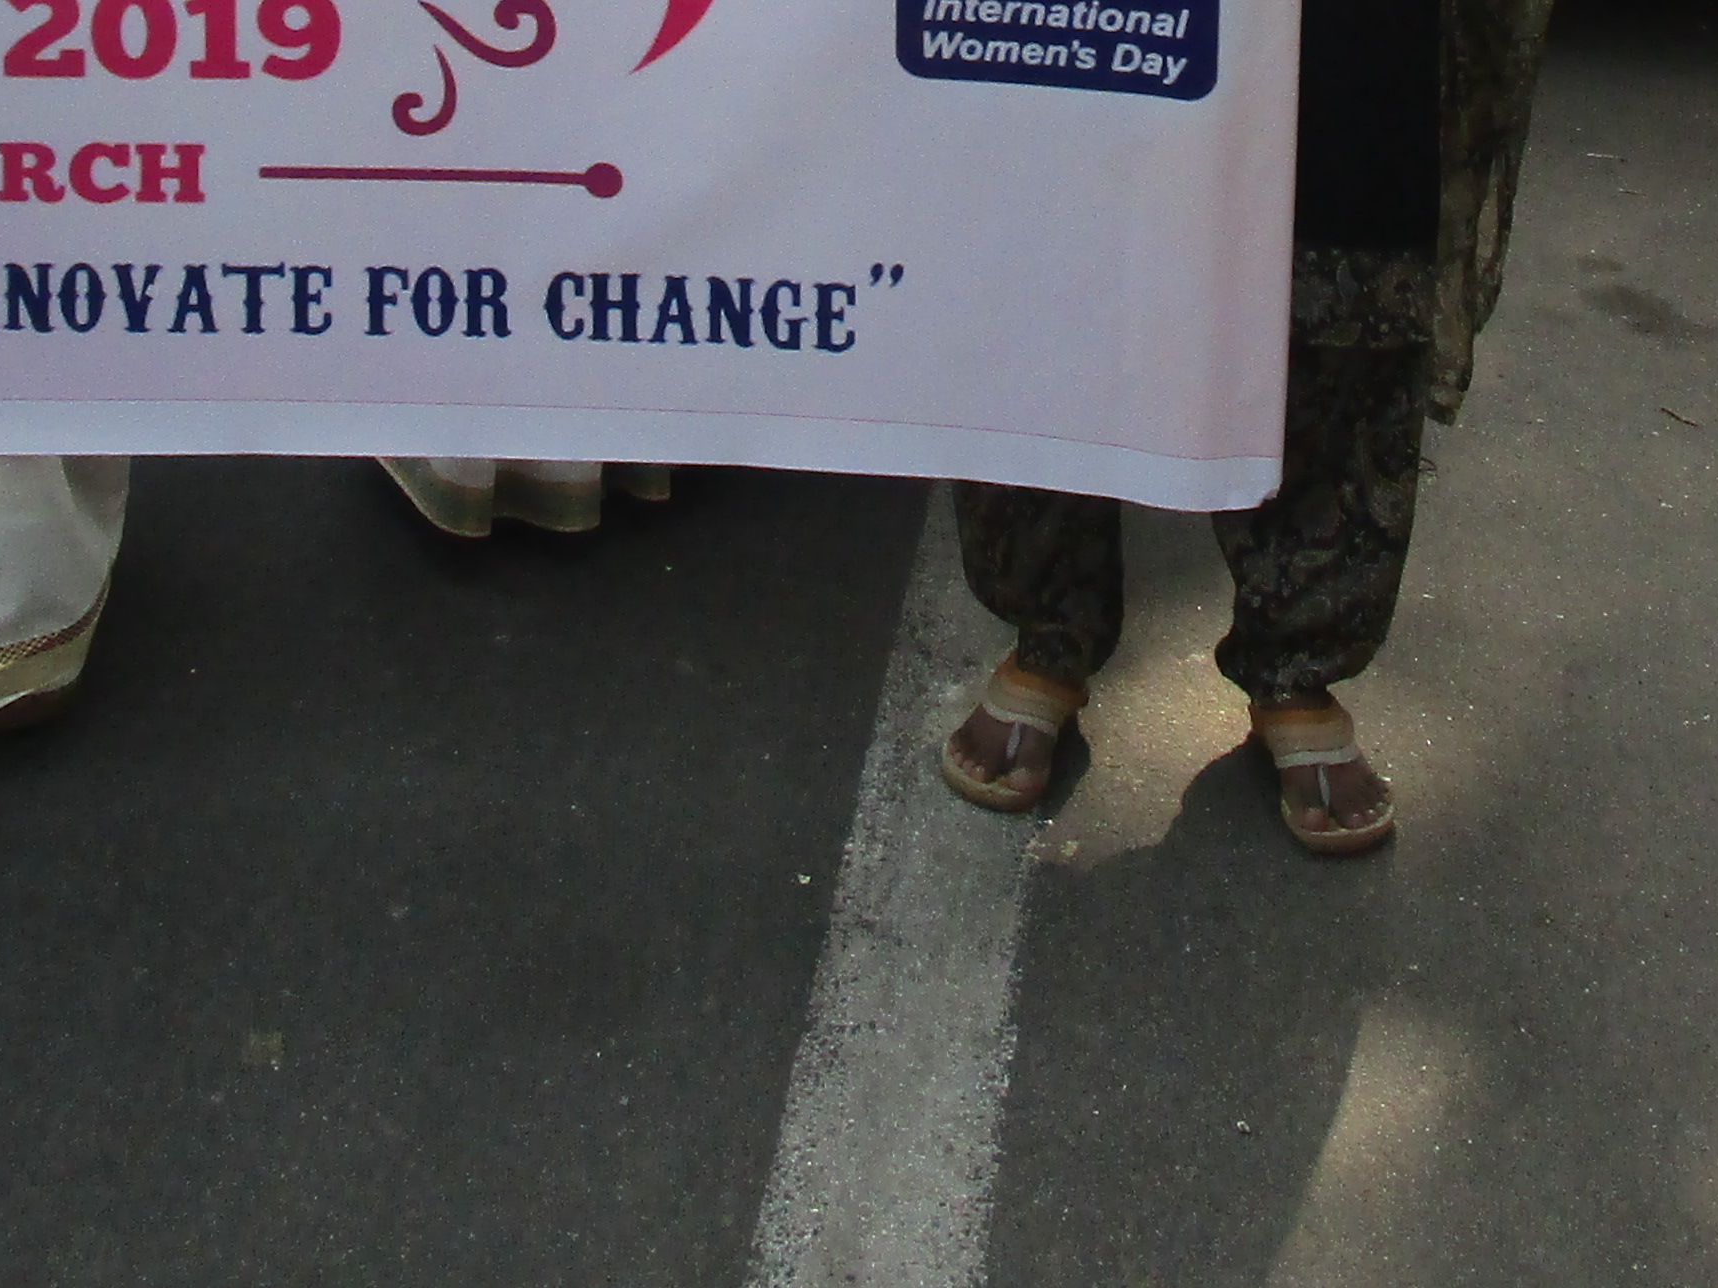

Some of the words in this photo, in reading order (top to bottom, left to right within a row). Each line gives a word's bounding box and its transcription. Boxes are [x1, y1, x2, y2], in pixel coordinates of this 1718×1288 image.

[922, 30, 1097, 69] Women's
[1111, 42, 1188, 85] Day
[365, 265, 512, 338] FOR
